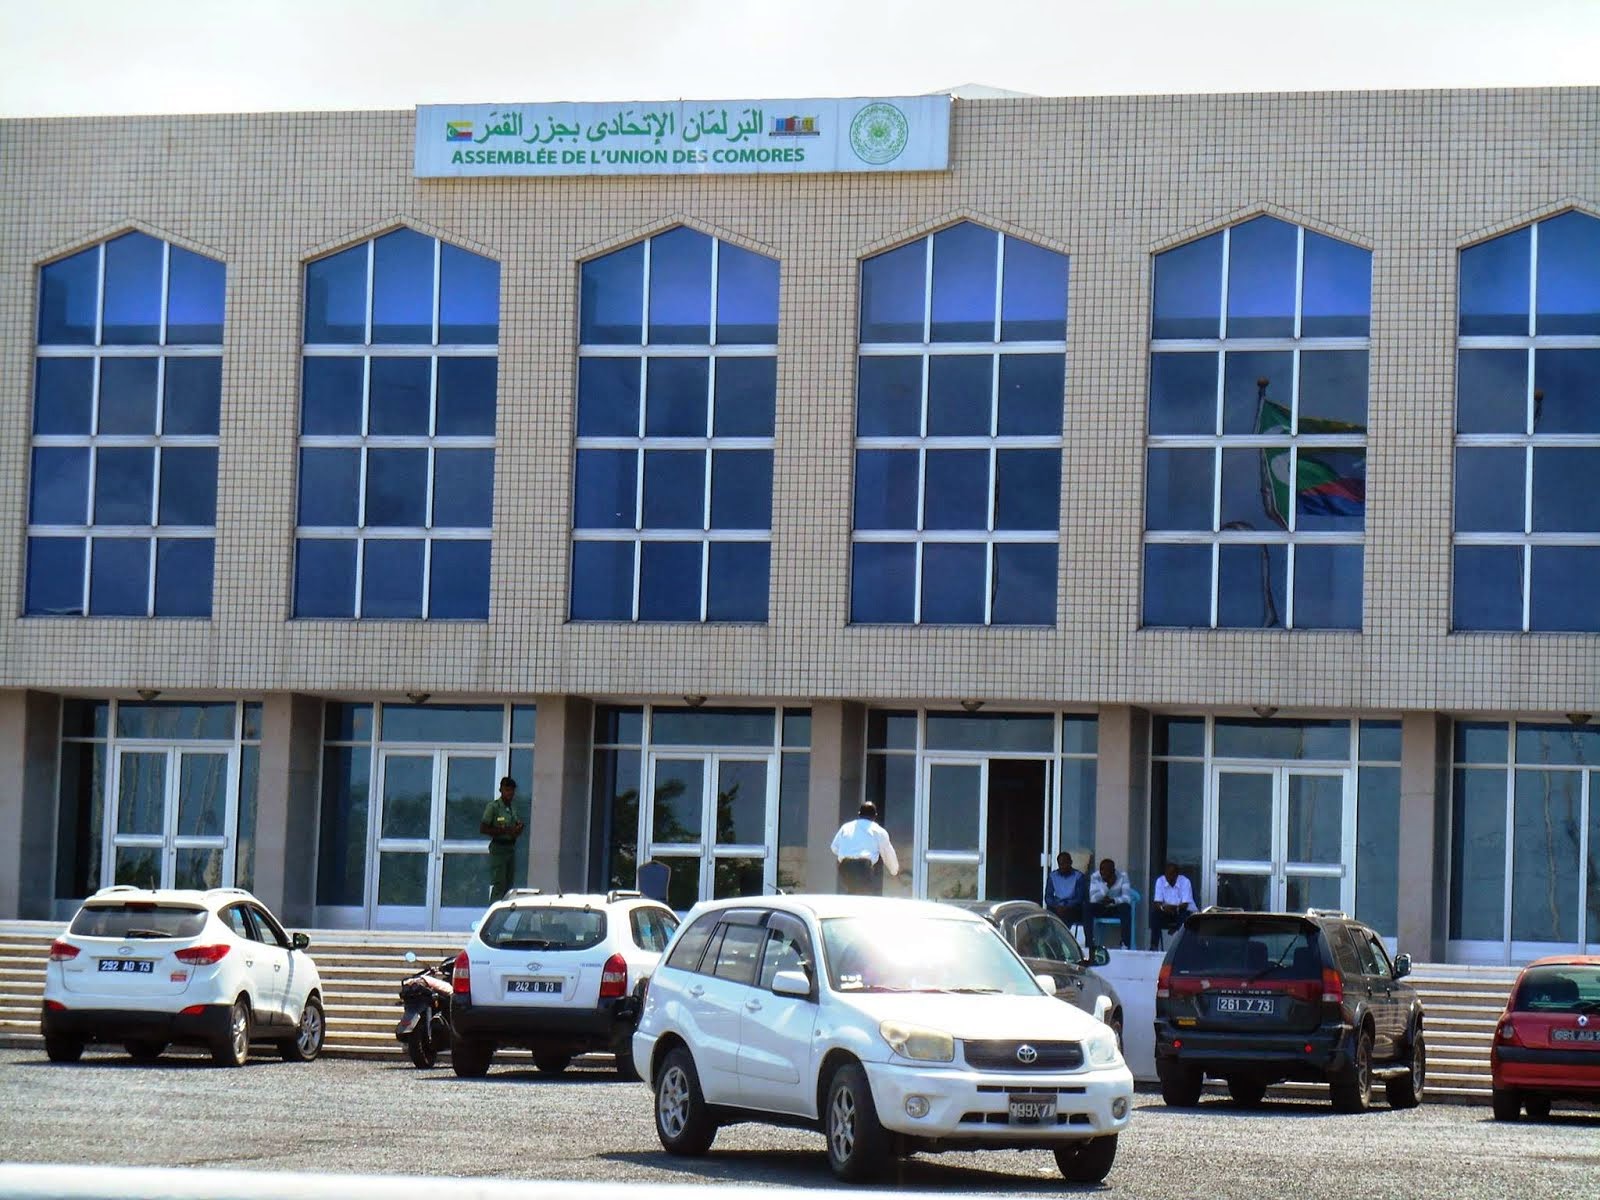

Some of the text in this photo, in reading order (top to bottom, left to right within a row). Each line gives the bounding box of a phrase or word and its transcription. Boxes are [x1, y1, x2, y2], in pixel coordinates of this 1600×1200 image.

[451, 148, 558, 165] ASSEMBLÉE
[562, 150, 587, 165] DE
[672, 149, 709, 164] DES
[712, 148, 806, 163] COMORES
[101, 961, 119, 970] 292
[139, 962, 151, 972] 73
[515, 981, 530, 992] 242
[544, 982, 555, 993] 73
[1220, 999, 1271, 1012] 261 Y 73
